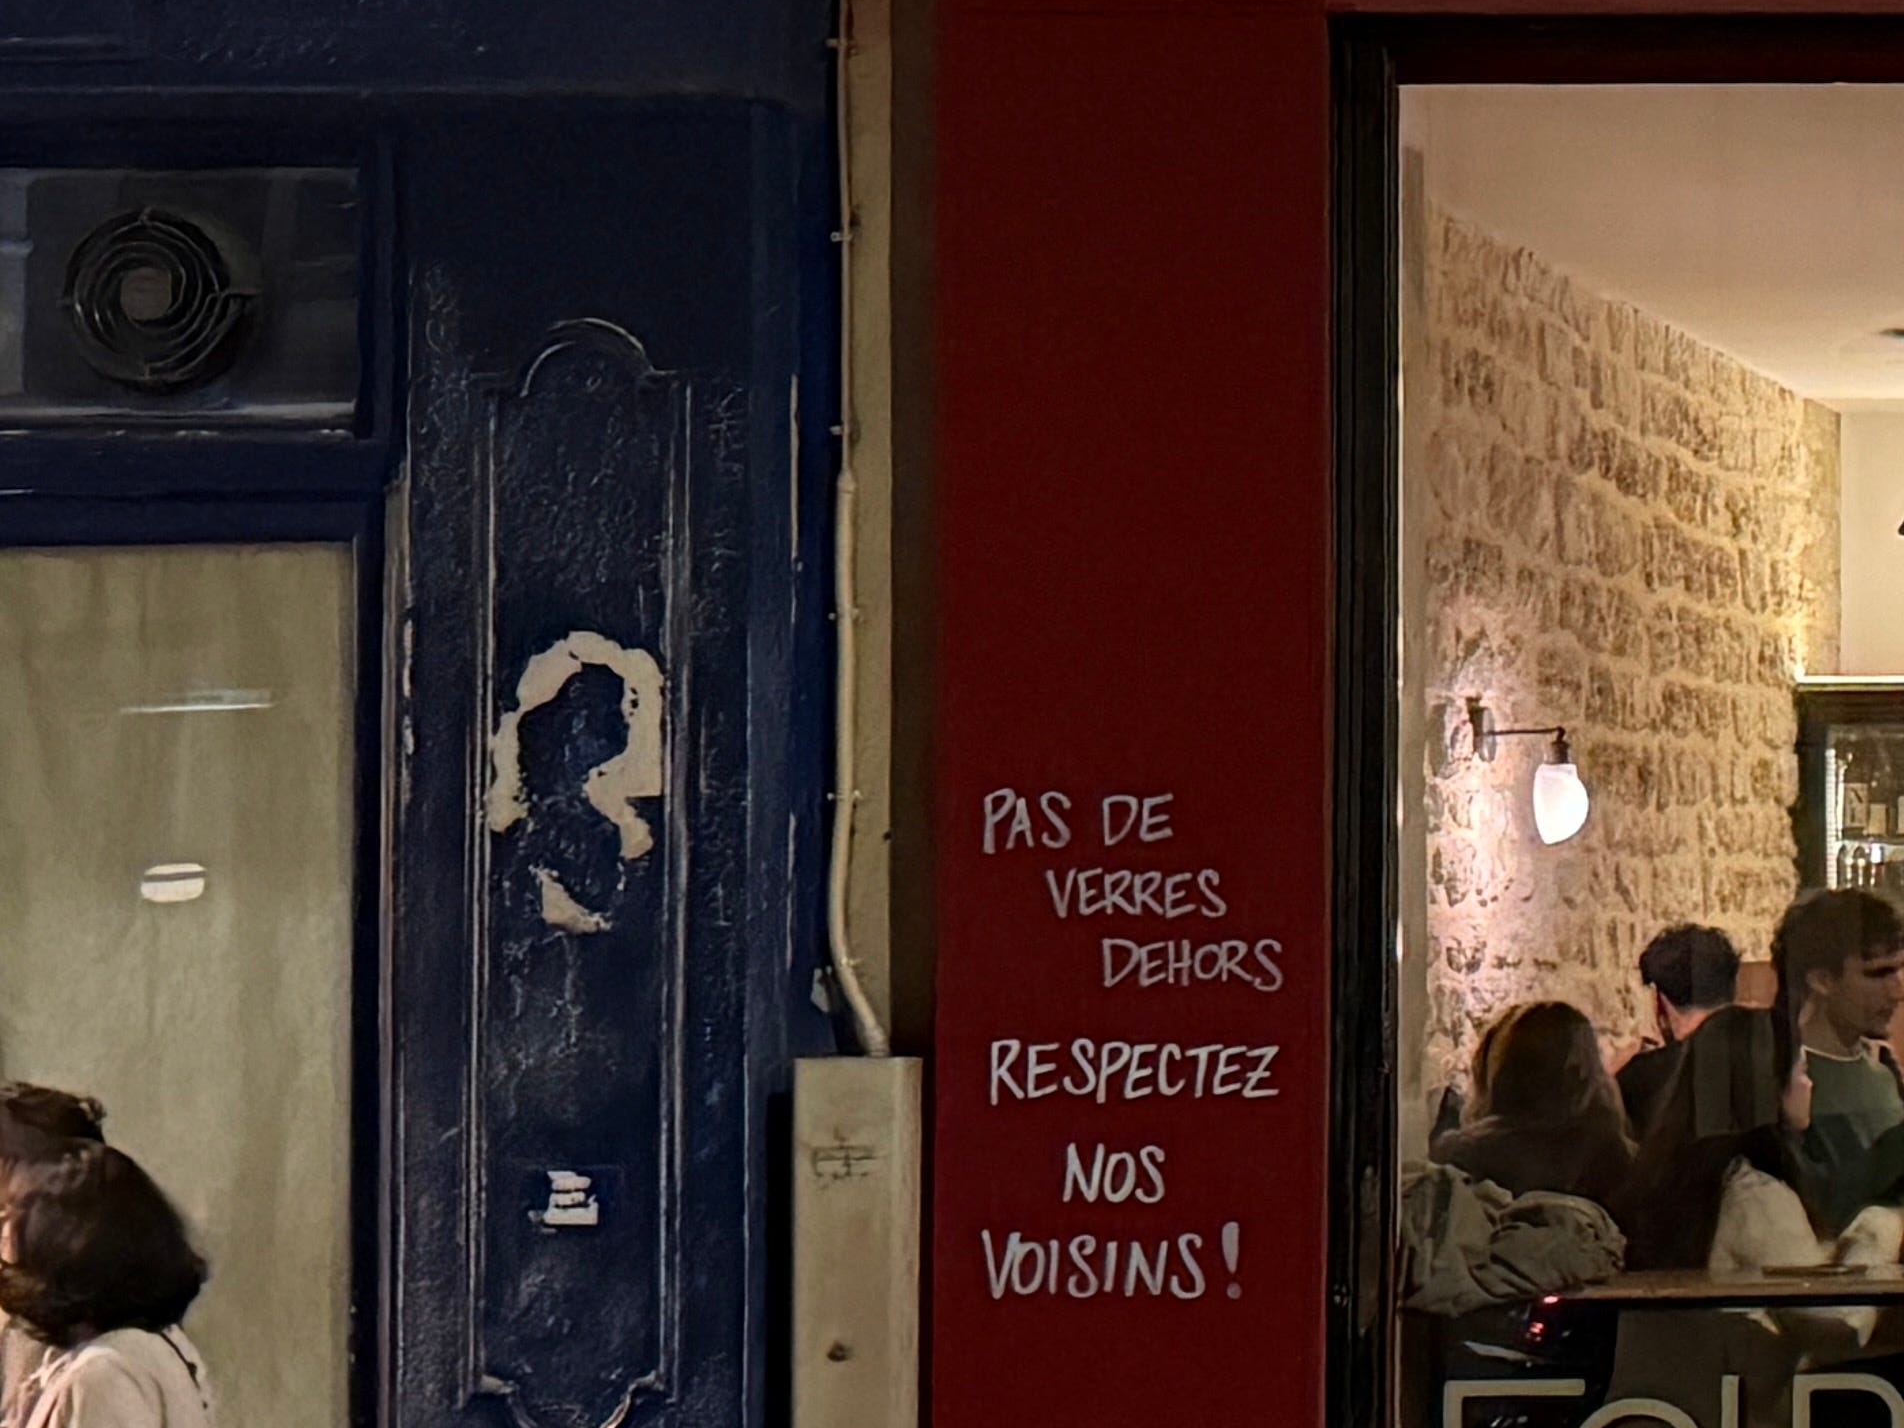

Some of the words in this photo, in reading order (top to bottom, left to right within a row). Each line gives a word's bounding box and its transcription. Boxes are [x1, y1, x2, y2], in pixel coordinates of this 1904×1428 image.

[983, 788, 1071, 854] PAS
[1103, 794, 1174, 846] DE
[1046, 868, 1227, 917] VERRES
[1103, 939, 1283, 992] DEHORS
[990, 1038, 1279, 1105] RESPECTEZ
[1063, 1143, 1165, 1203] NOS
